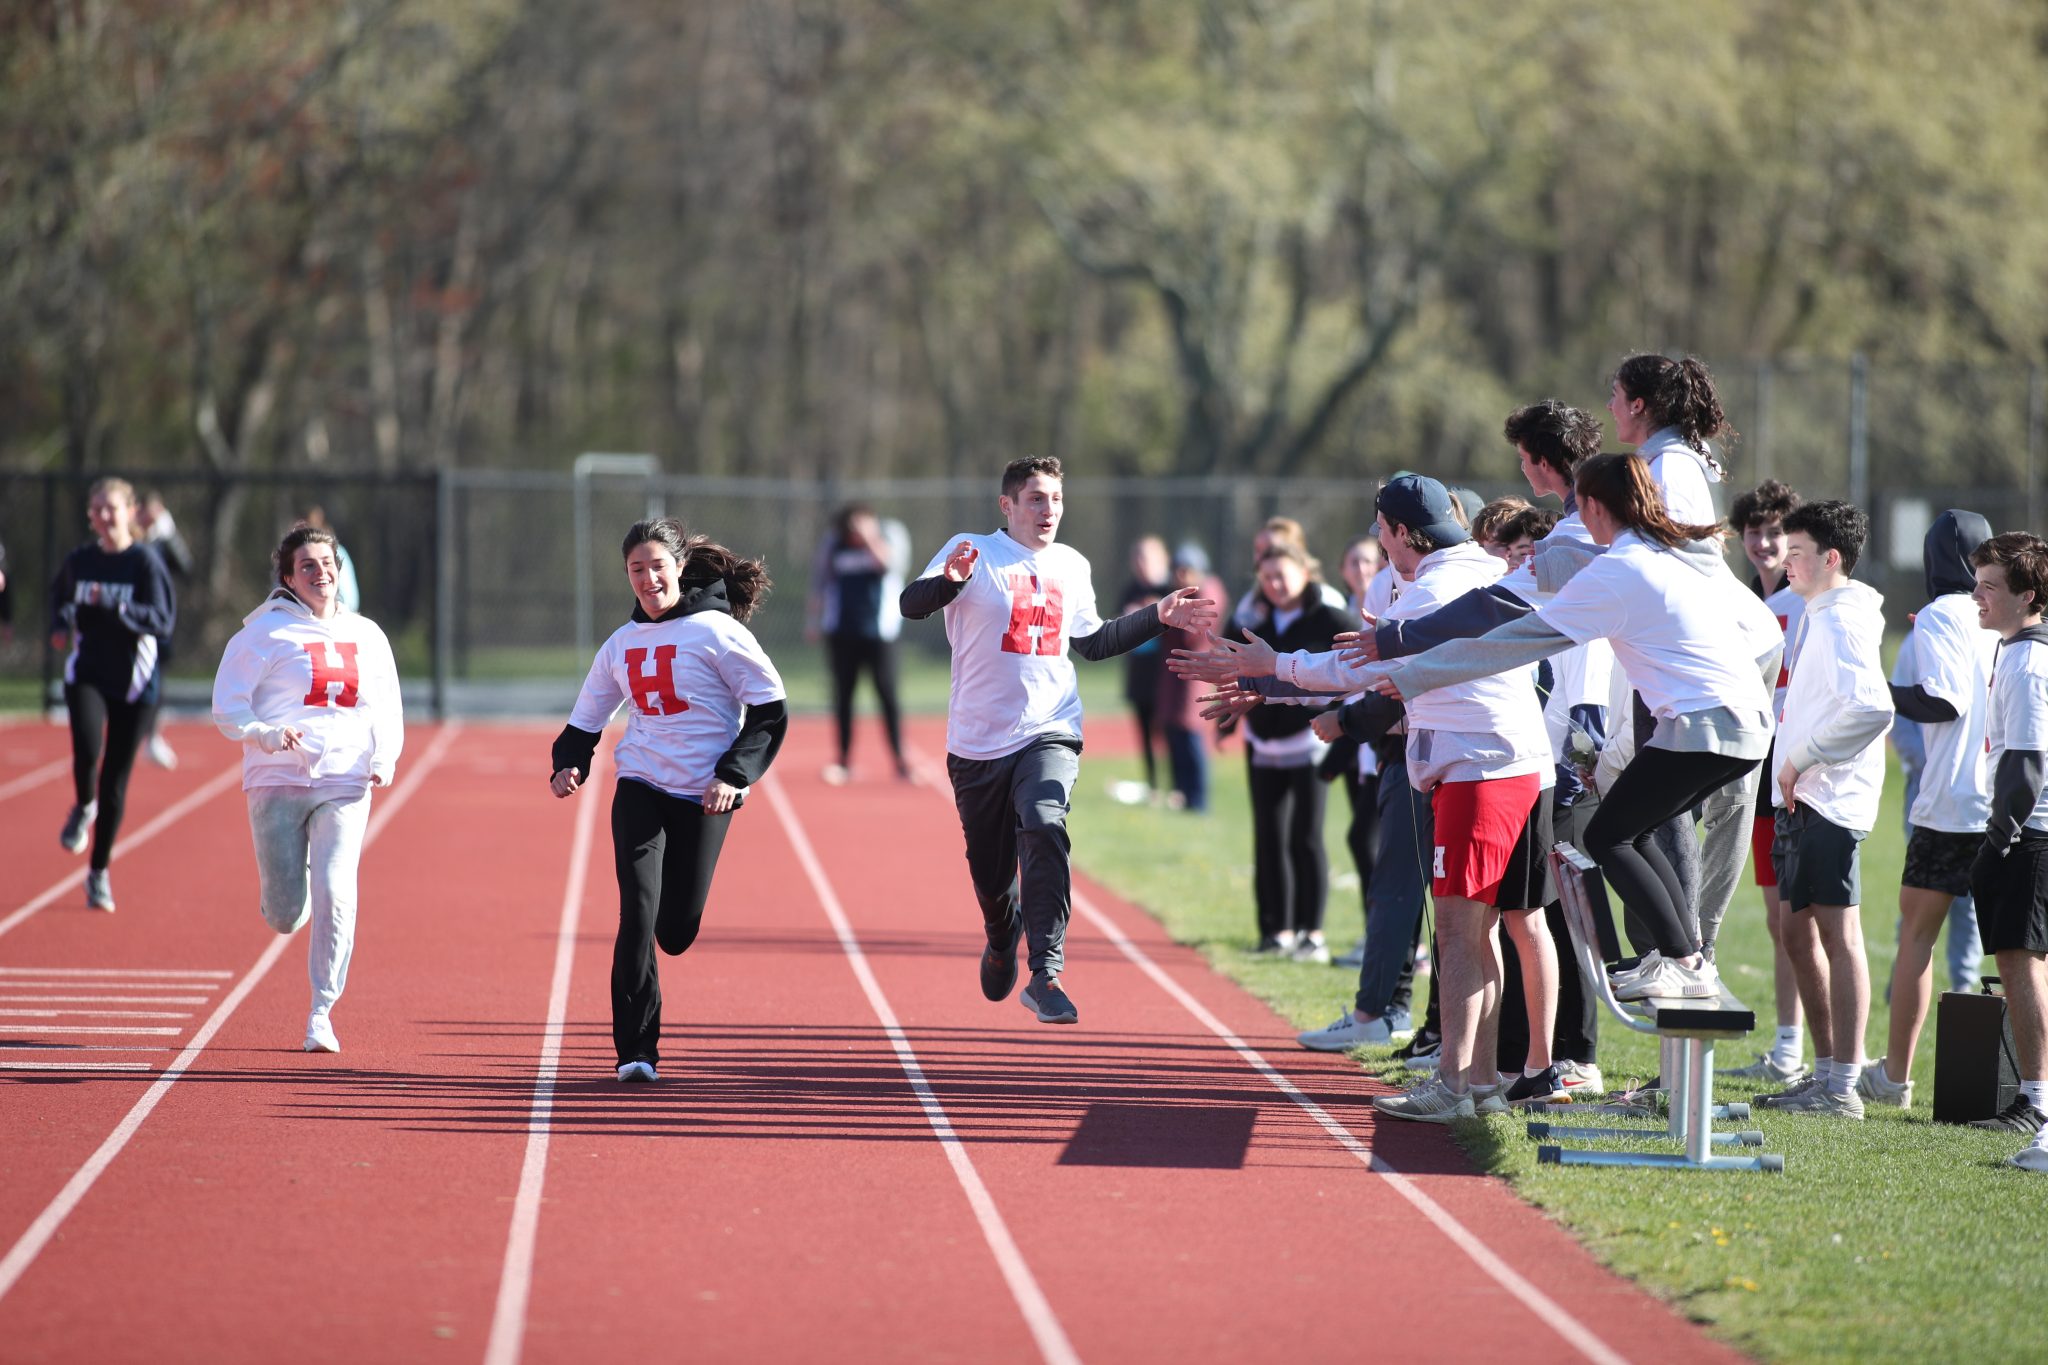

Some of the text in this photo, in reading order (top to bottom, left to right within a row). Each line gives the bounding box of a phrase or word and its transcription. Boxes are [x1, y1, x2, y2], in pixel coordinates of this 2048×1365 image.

[1001, 574, 1063, 656] H
[303, 642, 359, 707] H
[625, 645, 690, 716] H
